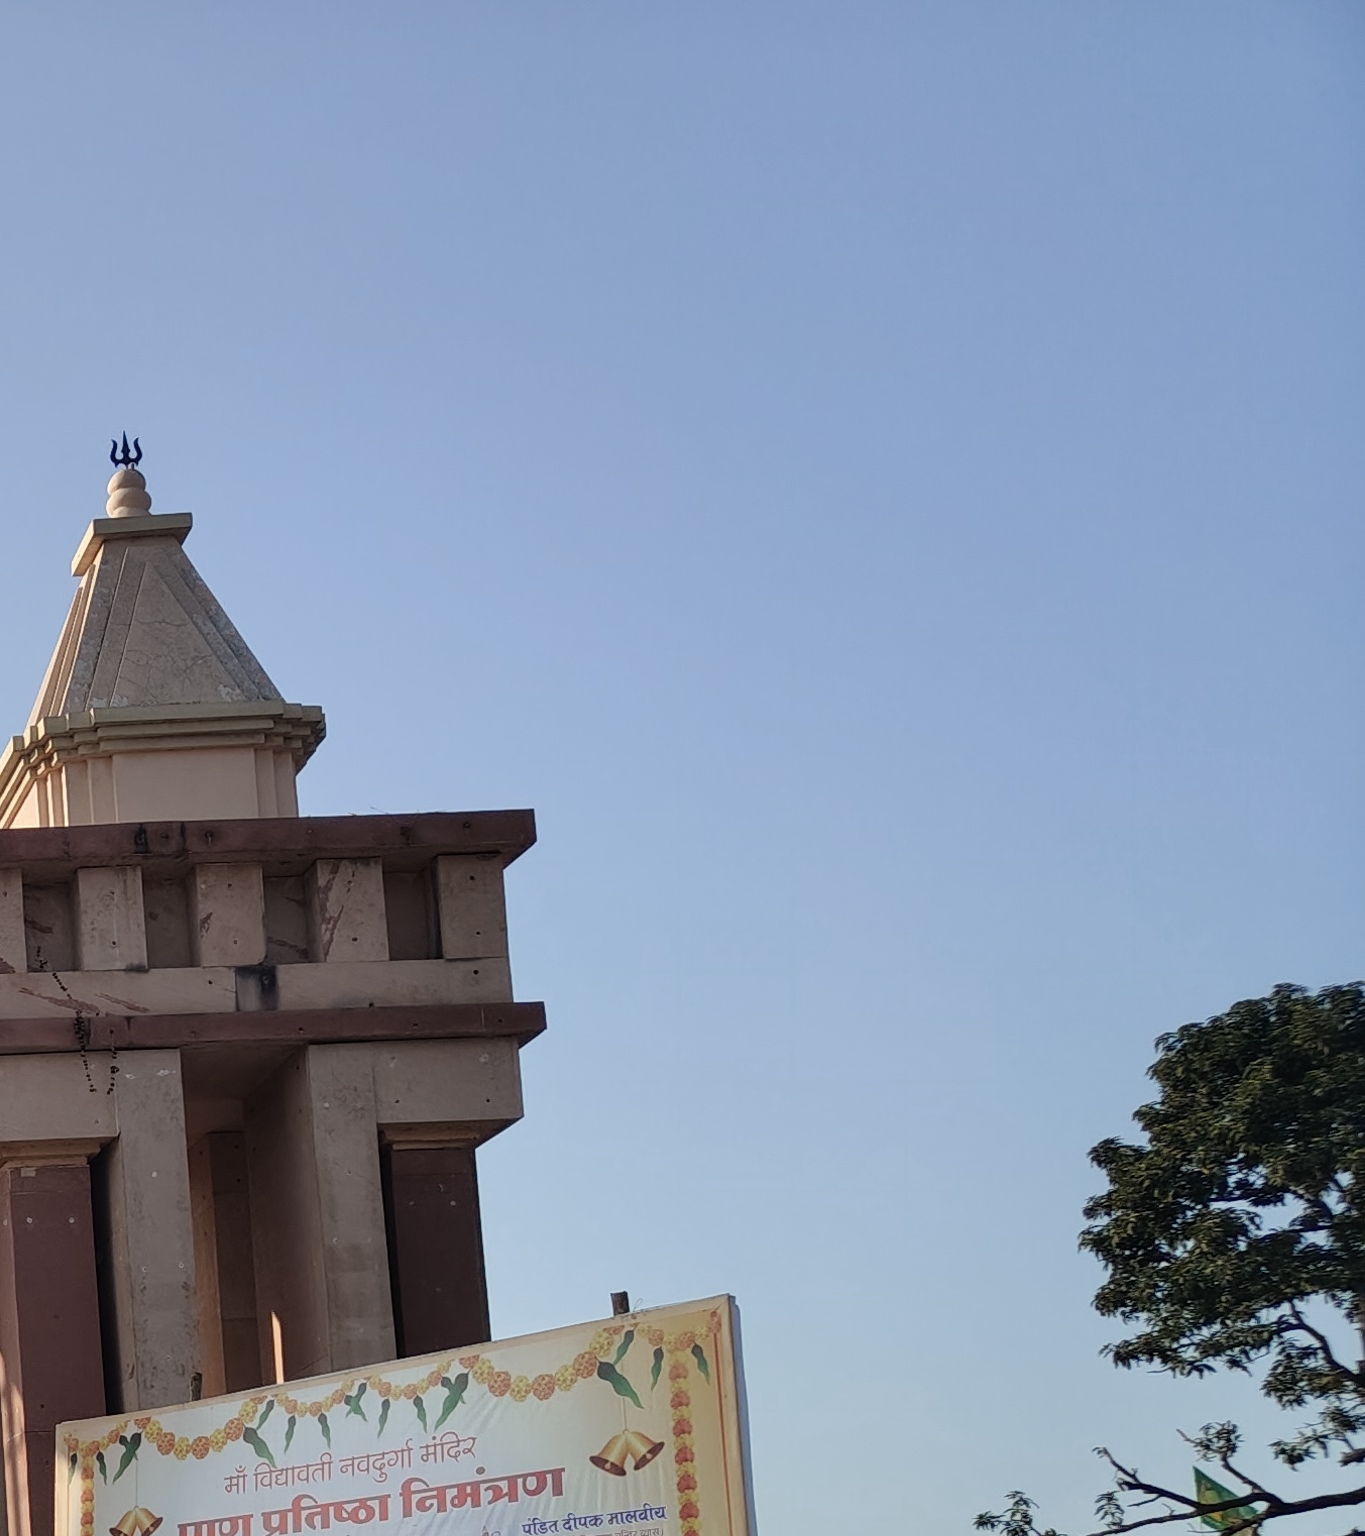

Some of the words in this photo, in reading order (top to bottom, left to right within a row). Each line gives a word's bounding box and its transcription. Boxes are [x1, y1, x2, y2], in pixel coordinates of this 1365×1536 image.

[224, 1465, 248, 1495] माँ
[254, 1452, 332, 1492] विद्यावती
[339, 1437, 413, 1483] नवदुर्गा
[420, 1431, 477, 1465] मंदिर
[401, 1467, 566, 1518] निमंत्रण
[522, 1517, 559, 1535] पंडित
[561, 1513, 603, 1531] दीपक
[606, 1503, 668, 1525] मालवीय
